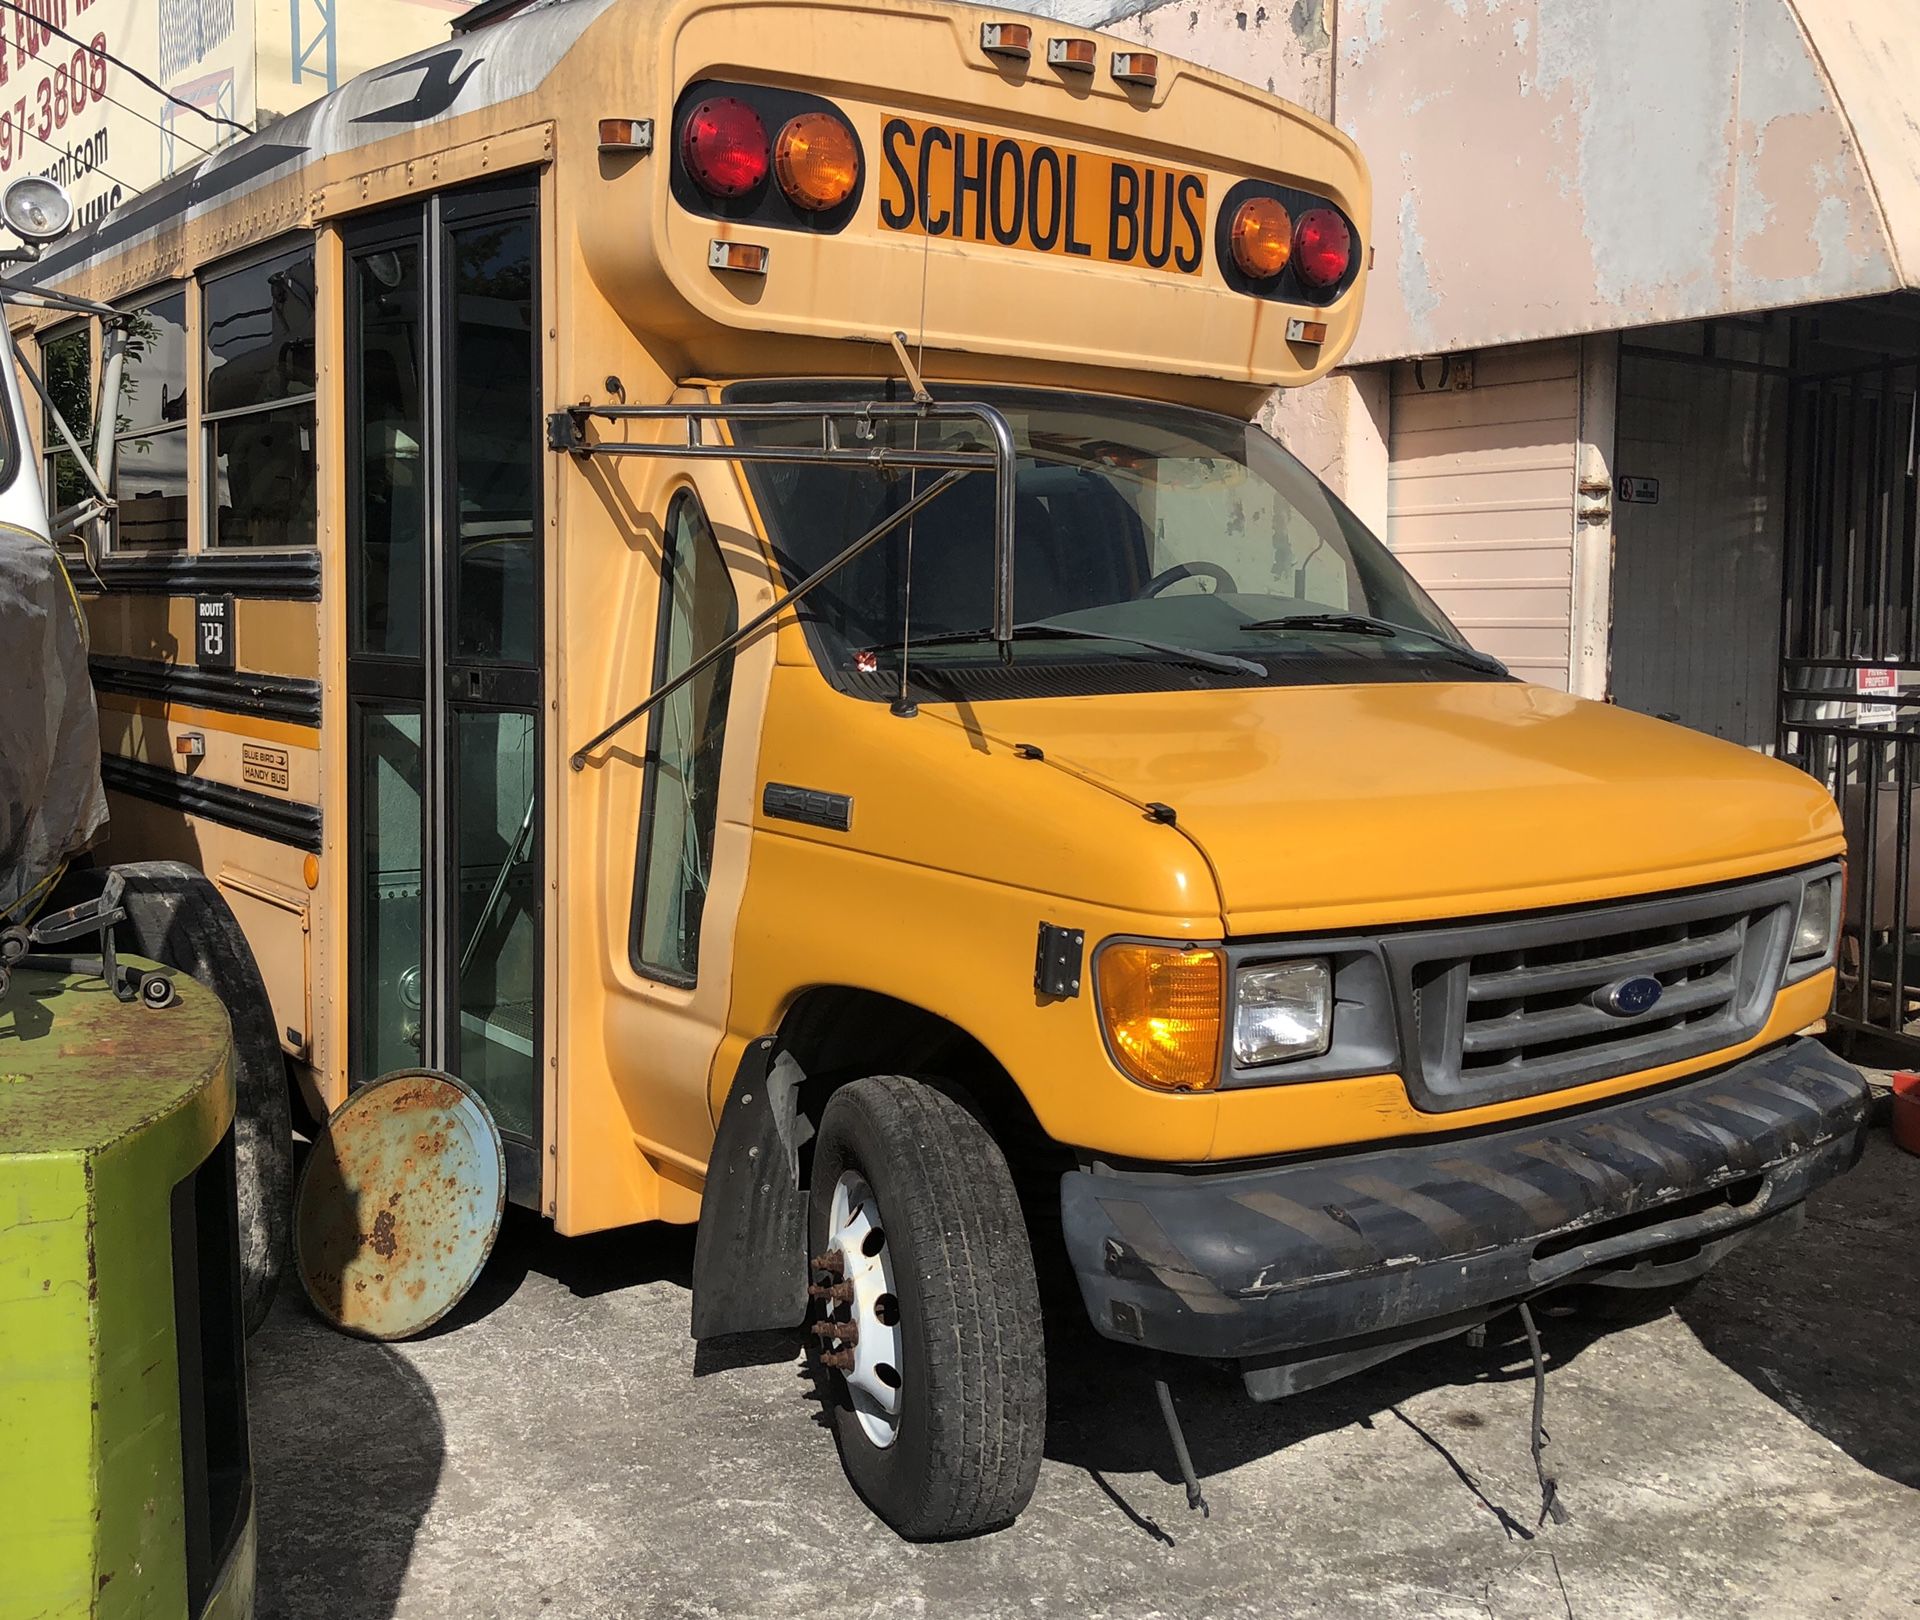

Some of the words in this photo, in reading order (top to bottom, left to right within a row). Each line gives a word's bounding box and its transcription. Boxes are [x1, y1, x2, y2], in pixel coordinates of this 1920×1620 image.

[880, 118, 1091, 257] SCHOOL
[1108, 162, 1205, 274] BUS
[199, 602, 225, 617] ROUTE
[244, 749, 259, 761] BLUE
[260, 752, 274, 764] BIRD
[245, 765, 269, 781] HANDY
[271, 772, 286, 785] BUS
